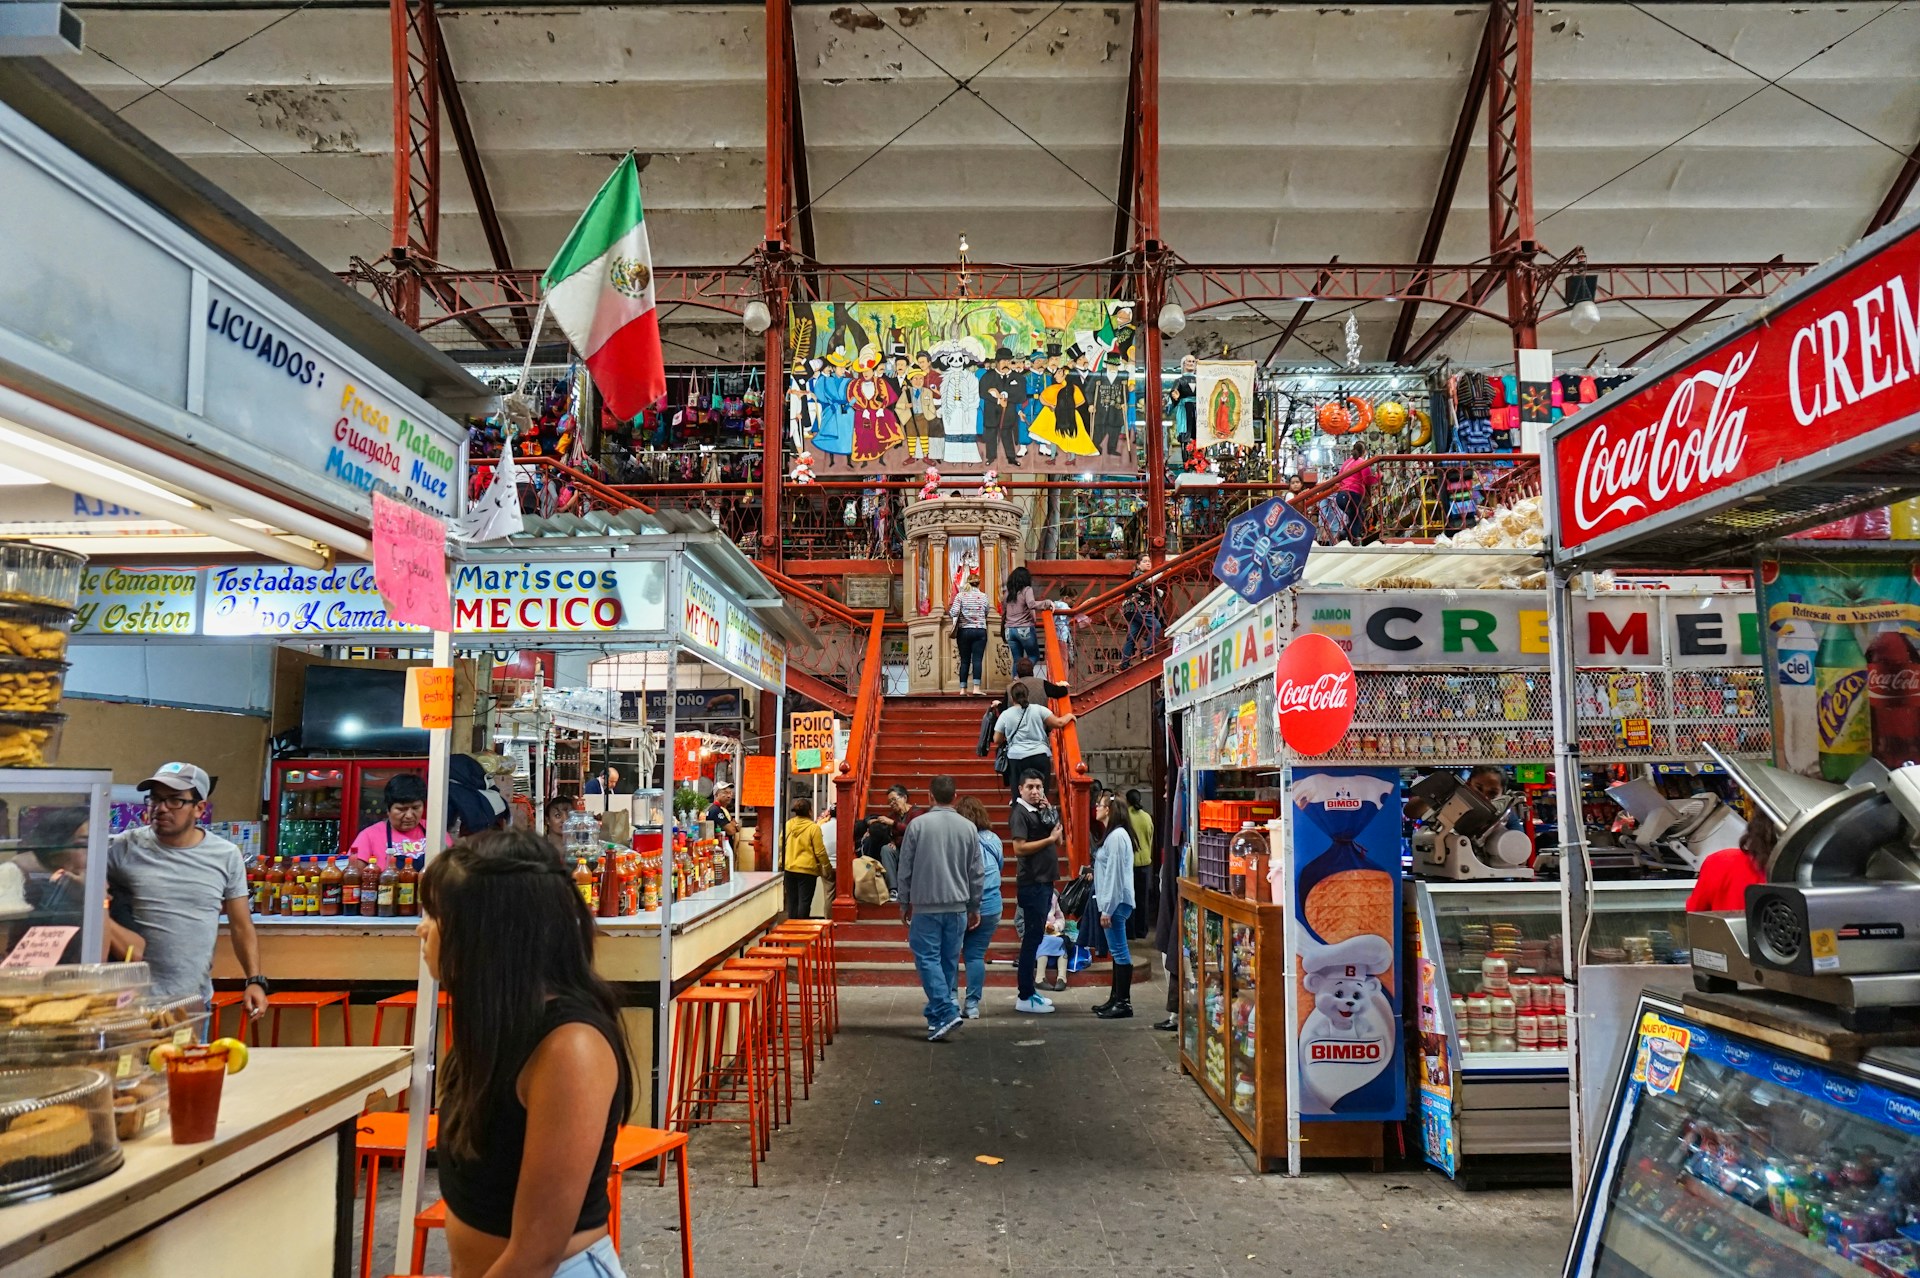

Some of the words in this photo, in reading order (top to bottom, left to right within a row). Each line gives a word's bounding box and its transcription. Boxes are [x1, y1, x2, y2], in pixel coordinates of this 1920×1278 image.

[207, 299, 325, 388] LICUADOS:
[340, 384, 391, 435] Fresa
[396, 419, 454, 472] Platano
[1575, 342, 1760, 530] Coca-Cola
[334, 417, 401, 473] Guayaba
[410, 459, 448, 499] Nuez
[1253, 536, 1271, 566] FUD
[104, 567, 196, 593] Camaron
[215, 567, 317, 592] Tostadas
[321, 567, 346, 591] de
[457, 562, 618, 590] Mariscos
[104, 601, 190, 629] Ostion
[457, 597, 622, 628] MECICO
[1312, 609, 1352, 620] JAMON
[1836, 611, 1847, 620] en
[1173, 624, 1258, 696] CREMERIA
[1787, 658, 1810, 675] ciel
[1868, 669, 1920, 690] Coca-Cola
[1277, 672, 1352, 714] Coca-Cola
[793, 733, 833, 749] FRESCO
[1345, 965, 1356, 977] B
[1642, 1023, 1668, 1034] NUEVO
[1311, 1044, 1380, 1060] BIMBO
[1724, 1044, 1751, 1061] DANONE
[1653, 1058, 1672, 1074] DANONE
[1772, 1061, 1801, 1078] DANONE
[1825, 1079, 1858, 1098] DANONE
